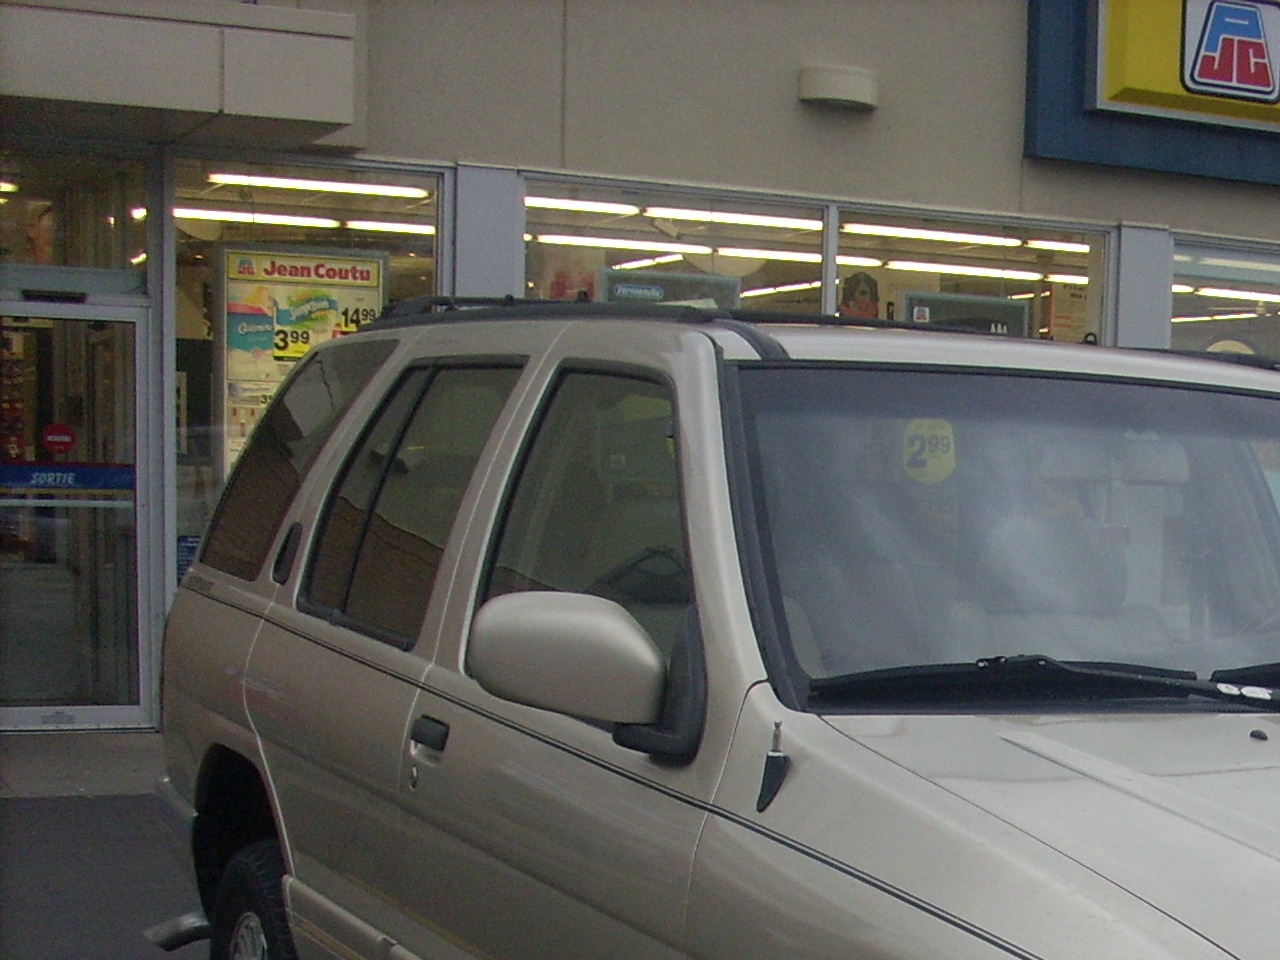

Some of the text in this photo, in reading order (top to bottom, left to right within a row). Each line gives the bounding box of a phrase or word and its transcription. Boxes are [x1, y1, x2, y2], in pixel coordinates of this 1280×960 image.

[263, 260, 372, 282] Jean Coutu
[274, 329, 311, 352] 399
[907, 432, 952, 469] 299
[31, 472, 77, 485] SORTIE
